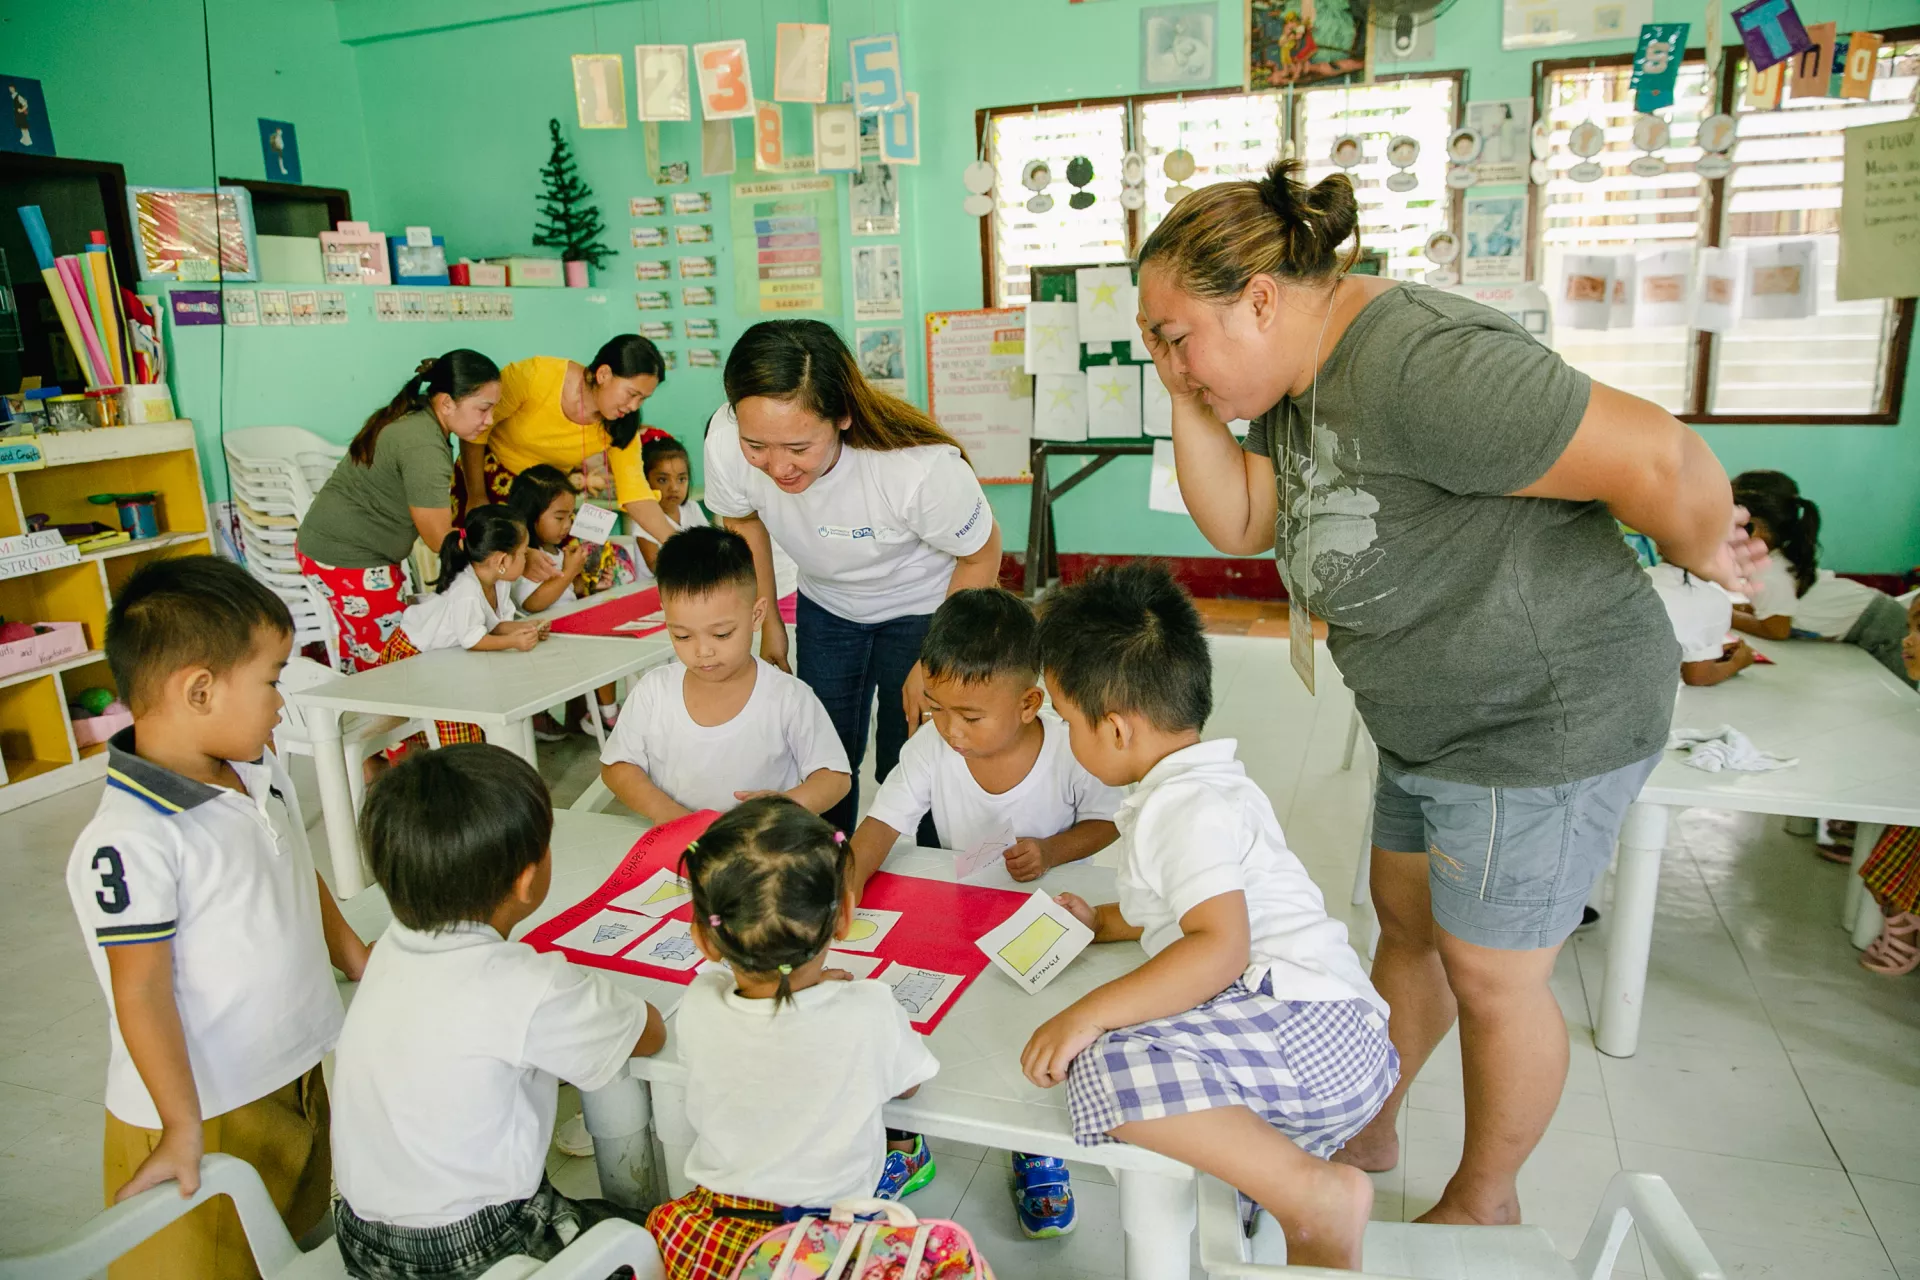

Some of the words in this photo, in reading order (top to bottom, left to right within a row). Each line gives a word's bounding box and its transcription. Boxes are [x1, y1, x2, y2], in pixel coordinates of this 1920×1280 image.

[1740, 0, 1789, 60] T
[589, 60, 614, 122] 1
[643, 52, 683, 117] 2
[703, 48, 748, 112] 3
[781, 33, 822, 96] 4
[853, 40, 898, 107] 5
[758, 107, 781, 166] 8
[820, 110, 855, 168] 9
[92, 846, 131, 914] 3
[550, 911, 578, 929] CAN
[606, 878, 624, 892] THE
[621, 848, 647, 879] SHAPES
[643, 837, 655, 848] TO
[1029, 954, 1060, 985] RECTANGLE
[1025, 1159, 1054, 1169] SPOR
